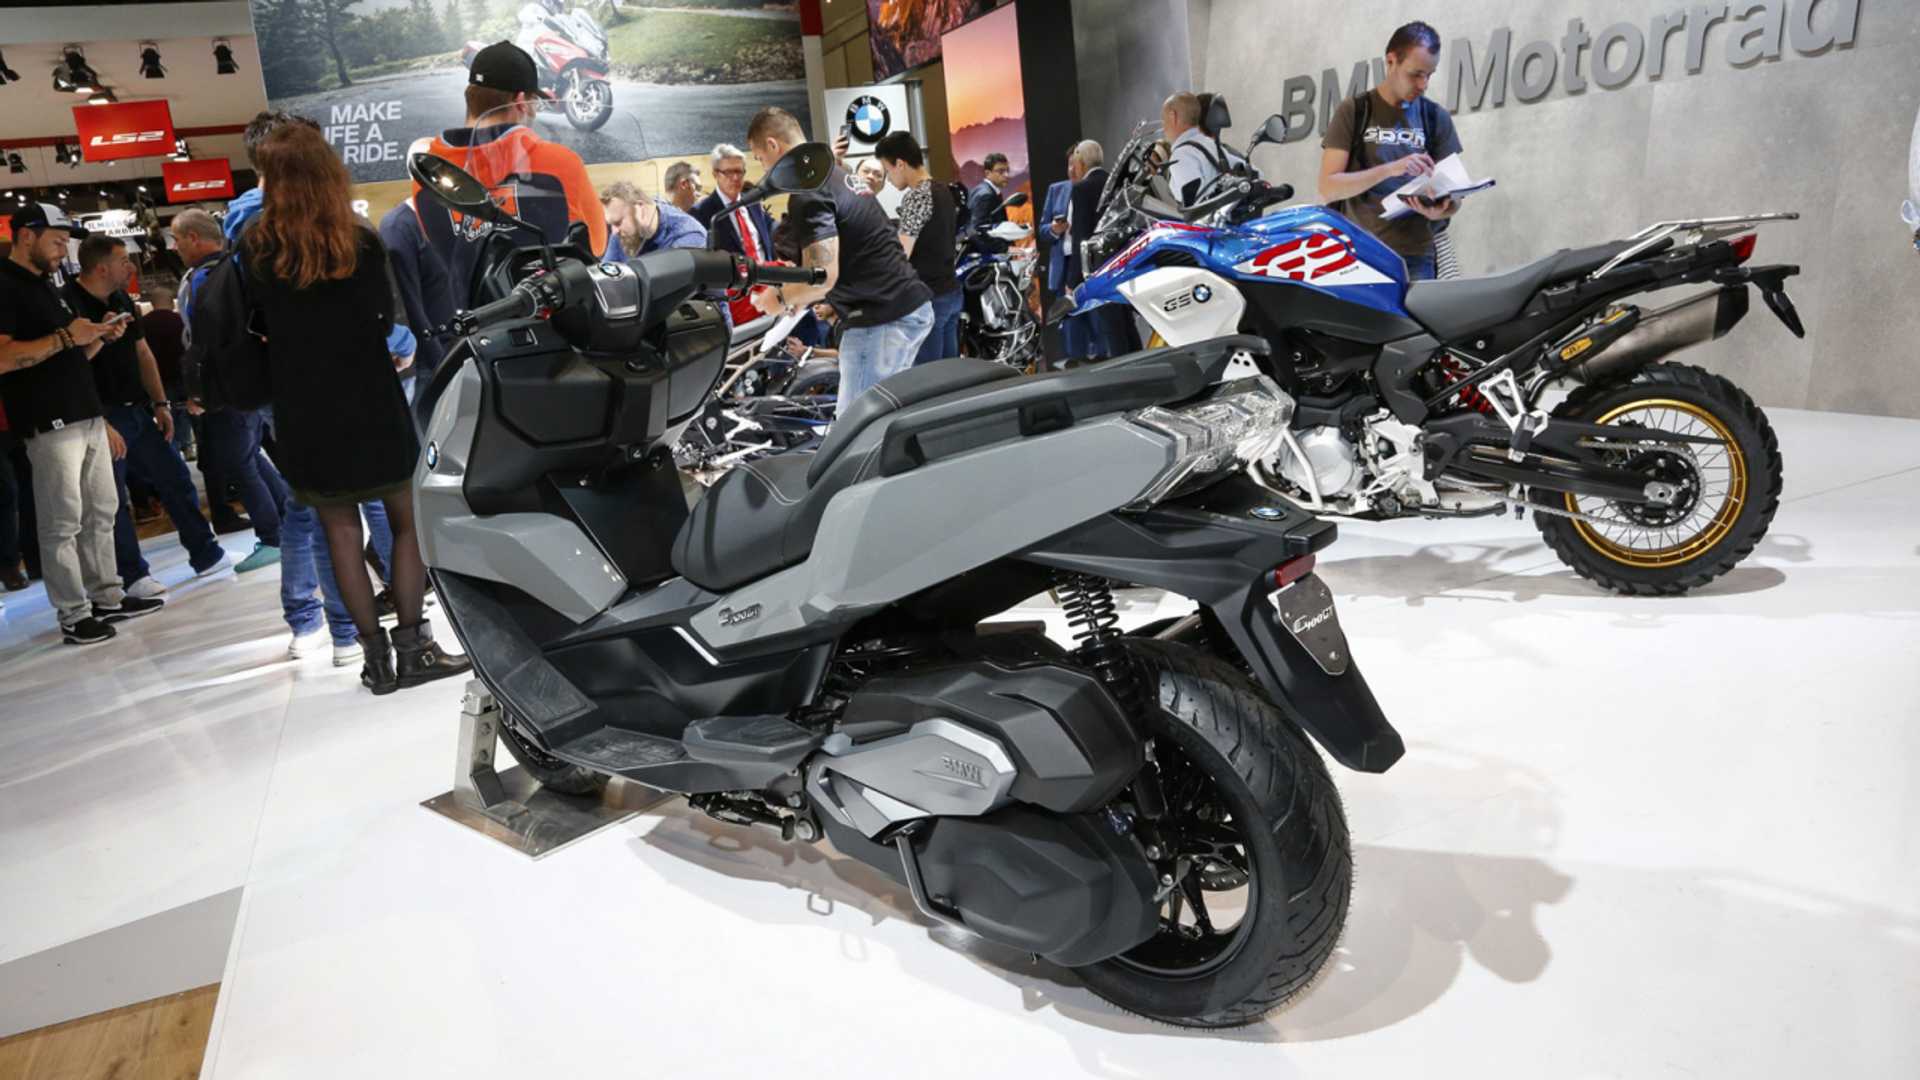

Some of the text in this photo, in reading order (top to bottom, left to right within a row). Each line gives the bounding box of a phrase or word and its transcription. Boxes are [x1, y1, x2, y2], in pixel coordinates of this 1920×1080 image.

[1279, 0, 1861, 144] BM Motorrad
[331, 101, 403, 124] MAKE
[90, 130, 165, 146] LS2
[324, 122, 384, 145] IFE A
[343, 142, 405, 165] RIDE.
[172, 179, 226, 192] LS2
[1164, 292, 1191, 312] GS
[941, 756, 983, 782] BMW
